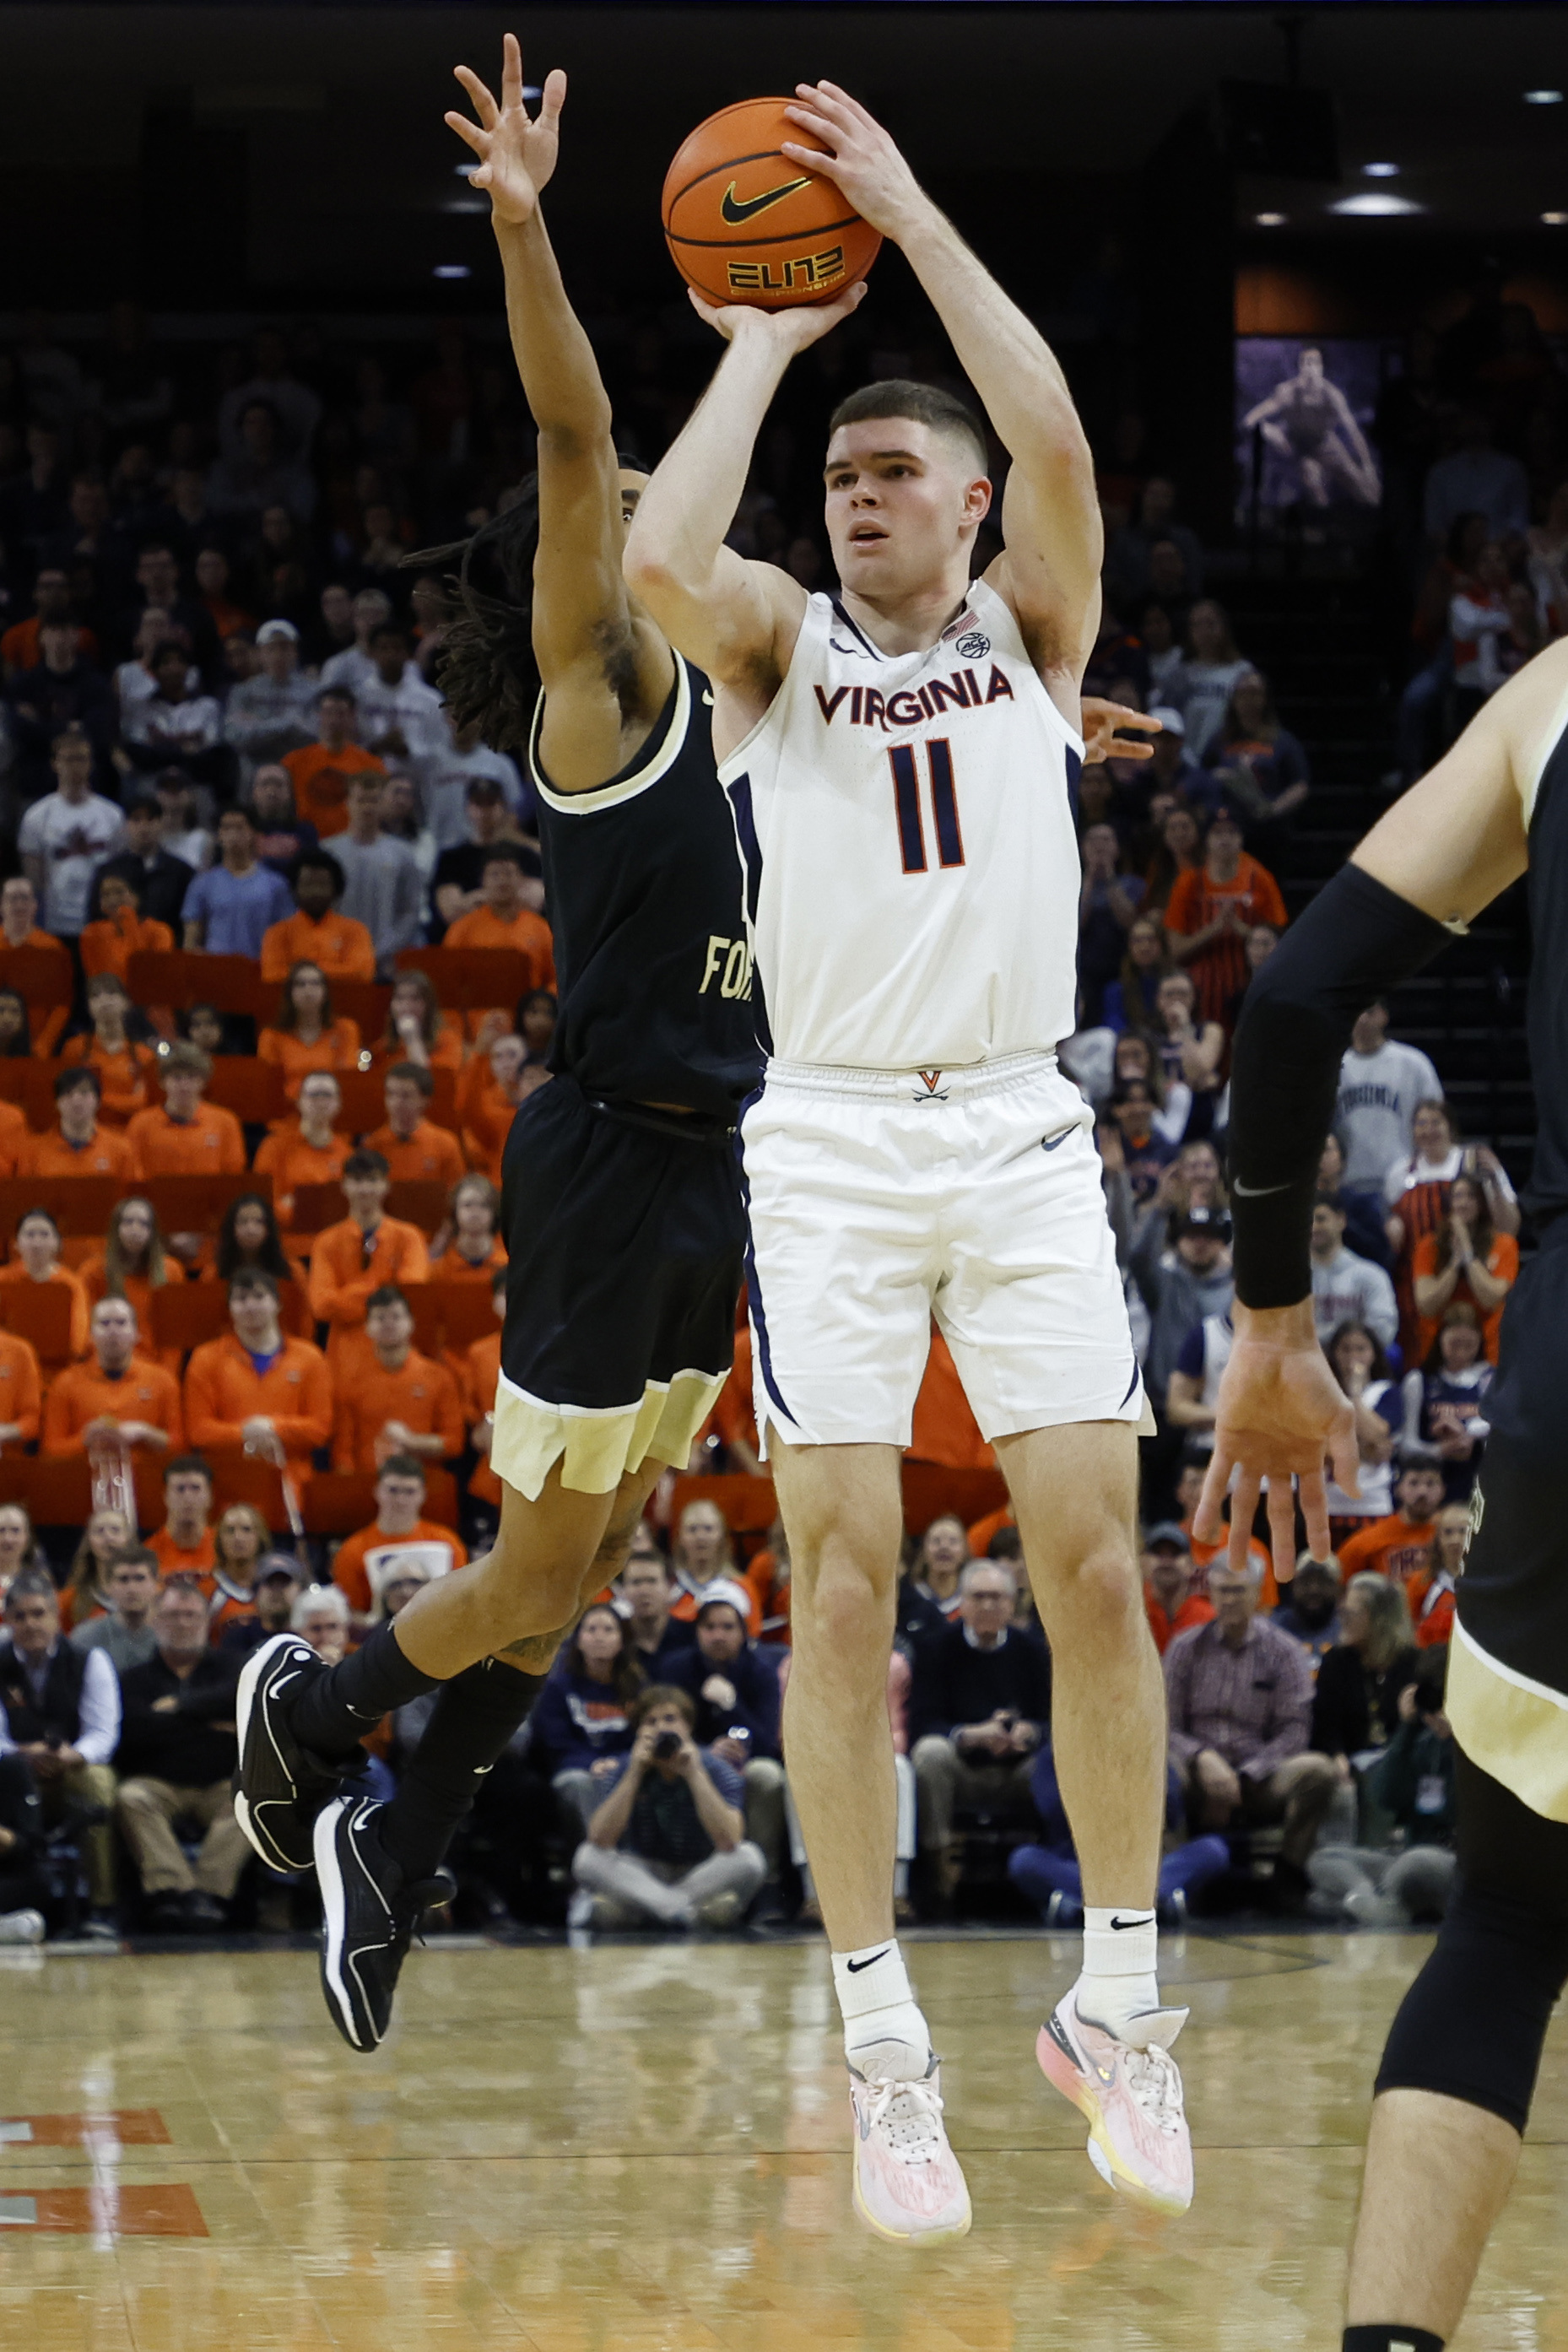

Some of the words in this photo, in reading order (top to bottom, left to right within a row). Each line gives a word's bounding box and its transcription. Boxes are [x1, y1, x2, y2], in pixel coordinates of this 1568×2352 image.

[727, 244, 845, 289] ELITE
[962, 635, 987, 650] ACC
[813, 662, 1015, 733] VIRGINIA
[887, 737, 965, 874] 11
